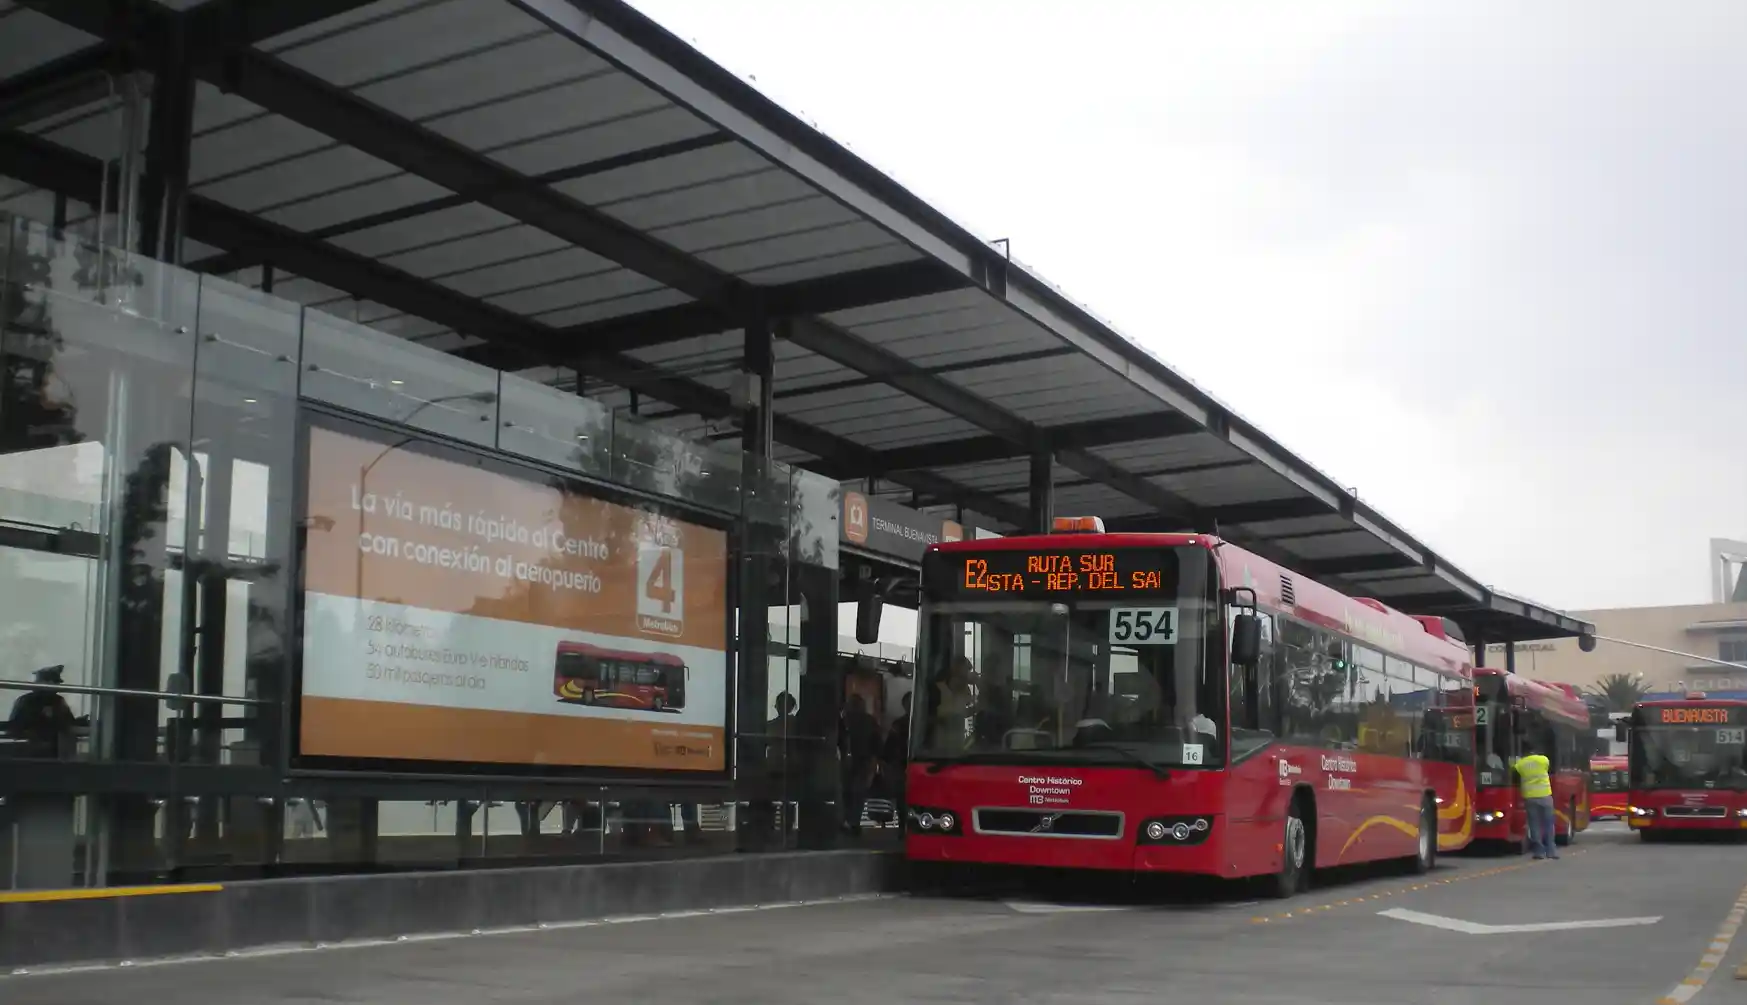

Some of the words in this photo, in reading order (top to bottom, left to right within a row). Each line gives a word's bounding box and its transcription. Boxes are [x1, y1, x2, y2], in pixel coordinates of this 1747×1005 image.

[352, 485, 376, 512] La
[384, 490, 412, 520] vía
[420, 503, 461, 531] más
[468, 509, 528, 543] rápido
[532, 529, 548, 550] al
[552, 531, 609, 560] Centro
[872, 516, 904, 537] TERMINAL
[904, 526, 939, 545] BUENAVISTA
[359, 532, 399, 557] con
[403, 541, 491, 573] conexión
[495, 555, 512, 577] al
[516, 563, 601, 593] aeropuerto
[965, 559, 987, 588] E2
[1028, 555, 1073, 573] RUTA
[1080, 554, 1114, 572] SUR
[645, 547, 676, 614] 4
[1047, 572, 1082, 590] REP.
[1089, 571, 1125, 589] DEL
[1114, 611, 1174, 640] 554
[1661, 708, 1728, 723] BUENAVISTA
[1185, 751, 1198, 762] 16
[1018, 775, 1046, 784] Centro
[1029, 785, 1071, 795] Downtown
